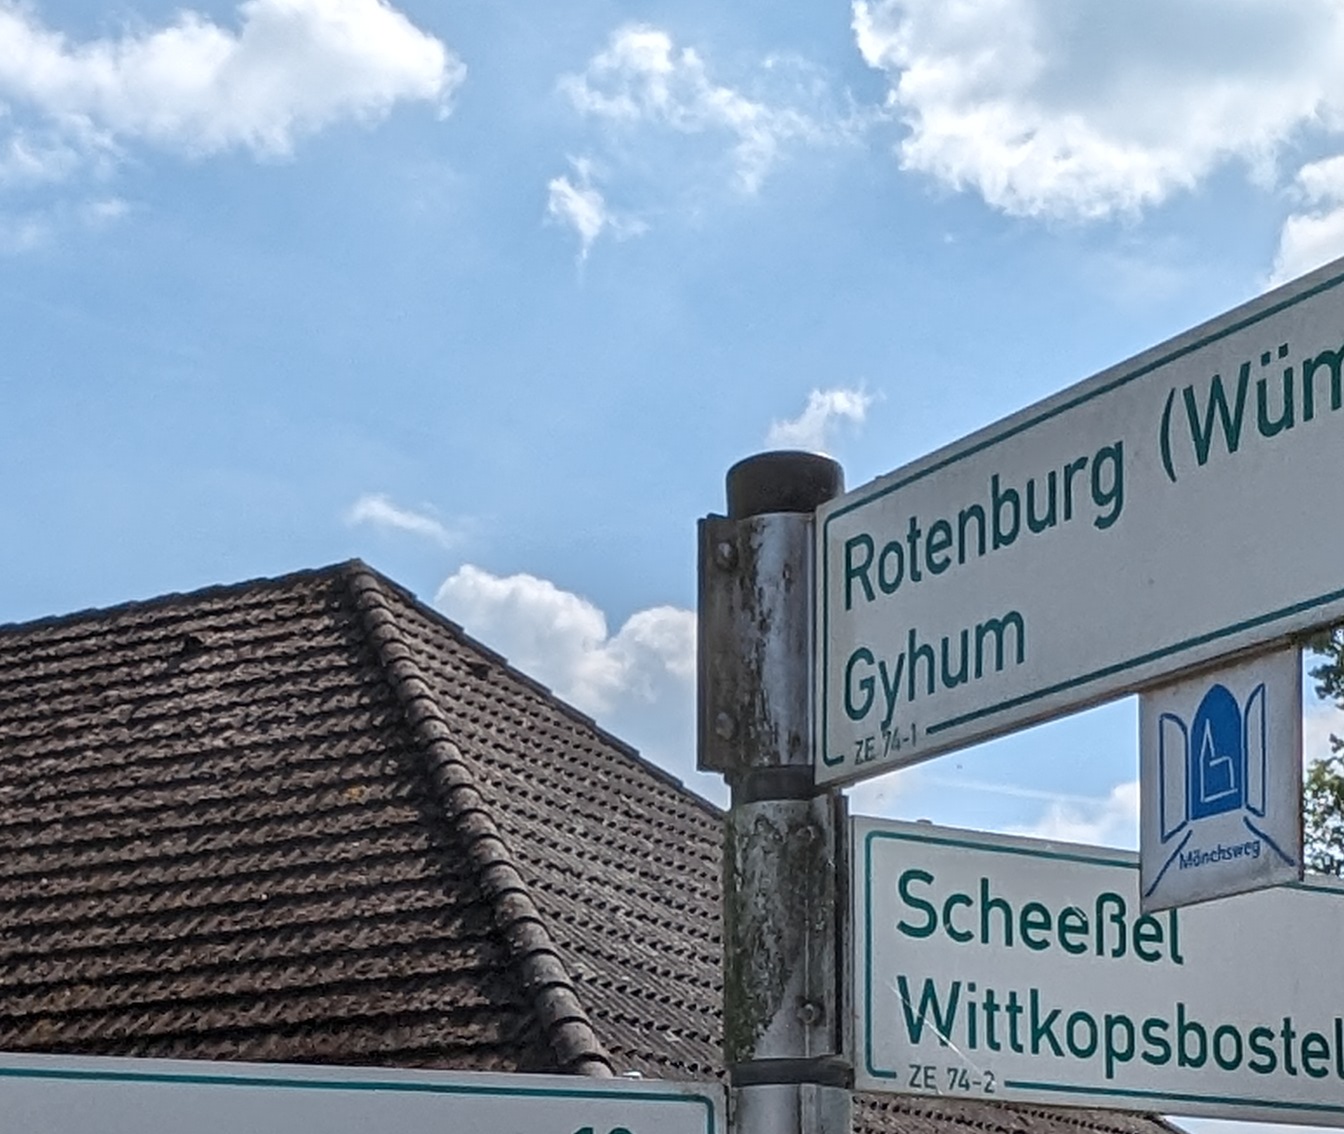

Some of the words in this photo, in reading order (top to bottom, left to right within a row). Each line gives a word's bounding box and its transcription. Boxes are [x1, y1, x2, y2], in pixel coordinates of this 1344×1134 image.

[845, 440, 1124, 611] Rotenburg
[844, 610, 1024, 732] Gyhum
[854, 736, 876, 765] ZE
[882, 722, 917, 758] 74-1
[1179, 840, 1261, 871] Mönchsweg
[896, 869, 1184, 966] Scheeßel
[909, 1064, 937, 1090] ZE
[947, 1067, 996, 1094] 74-2
